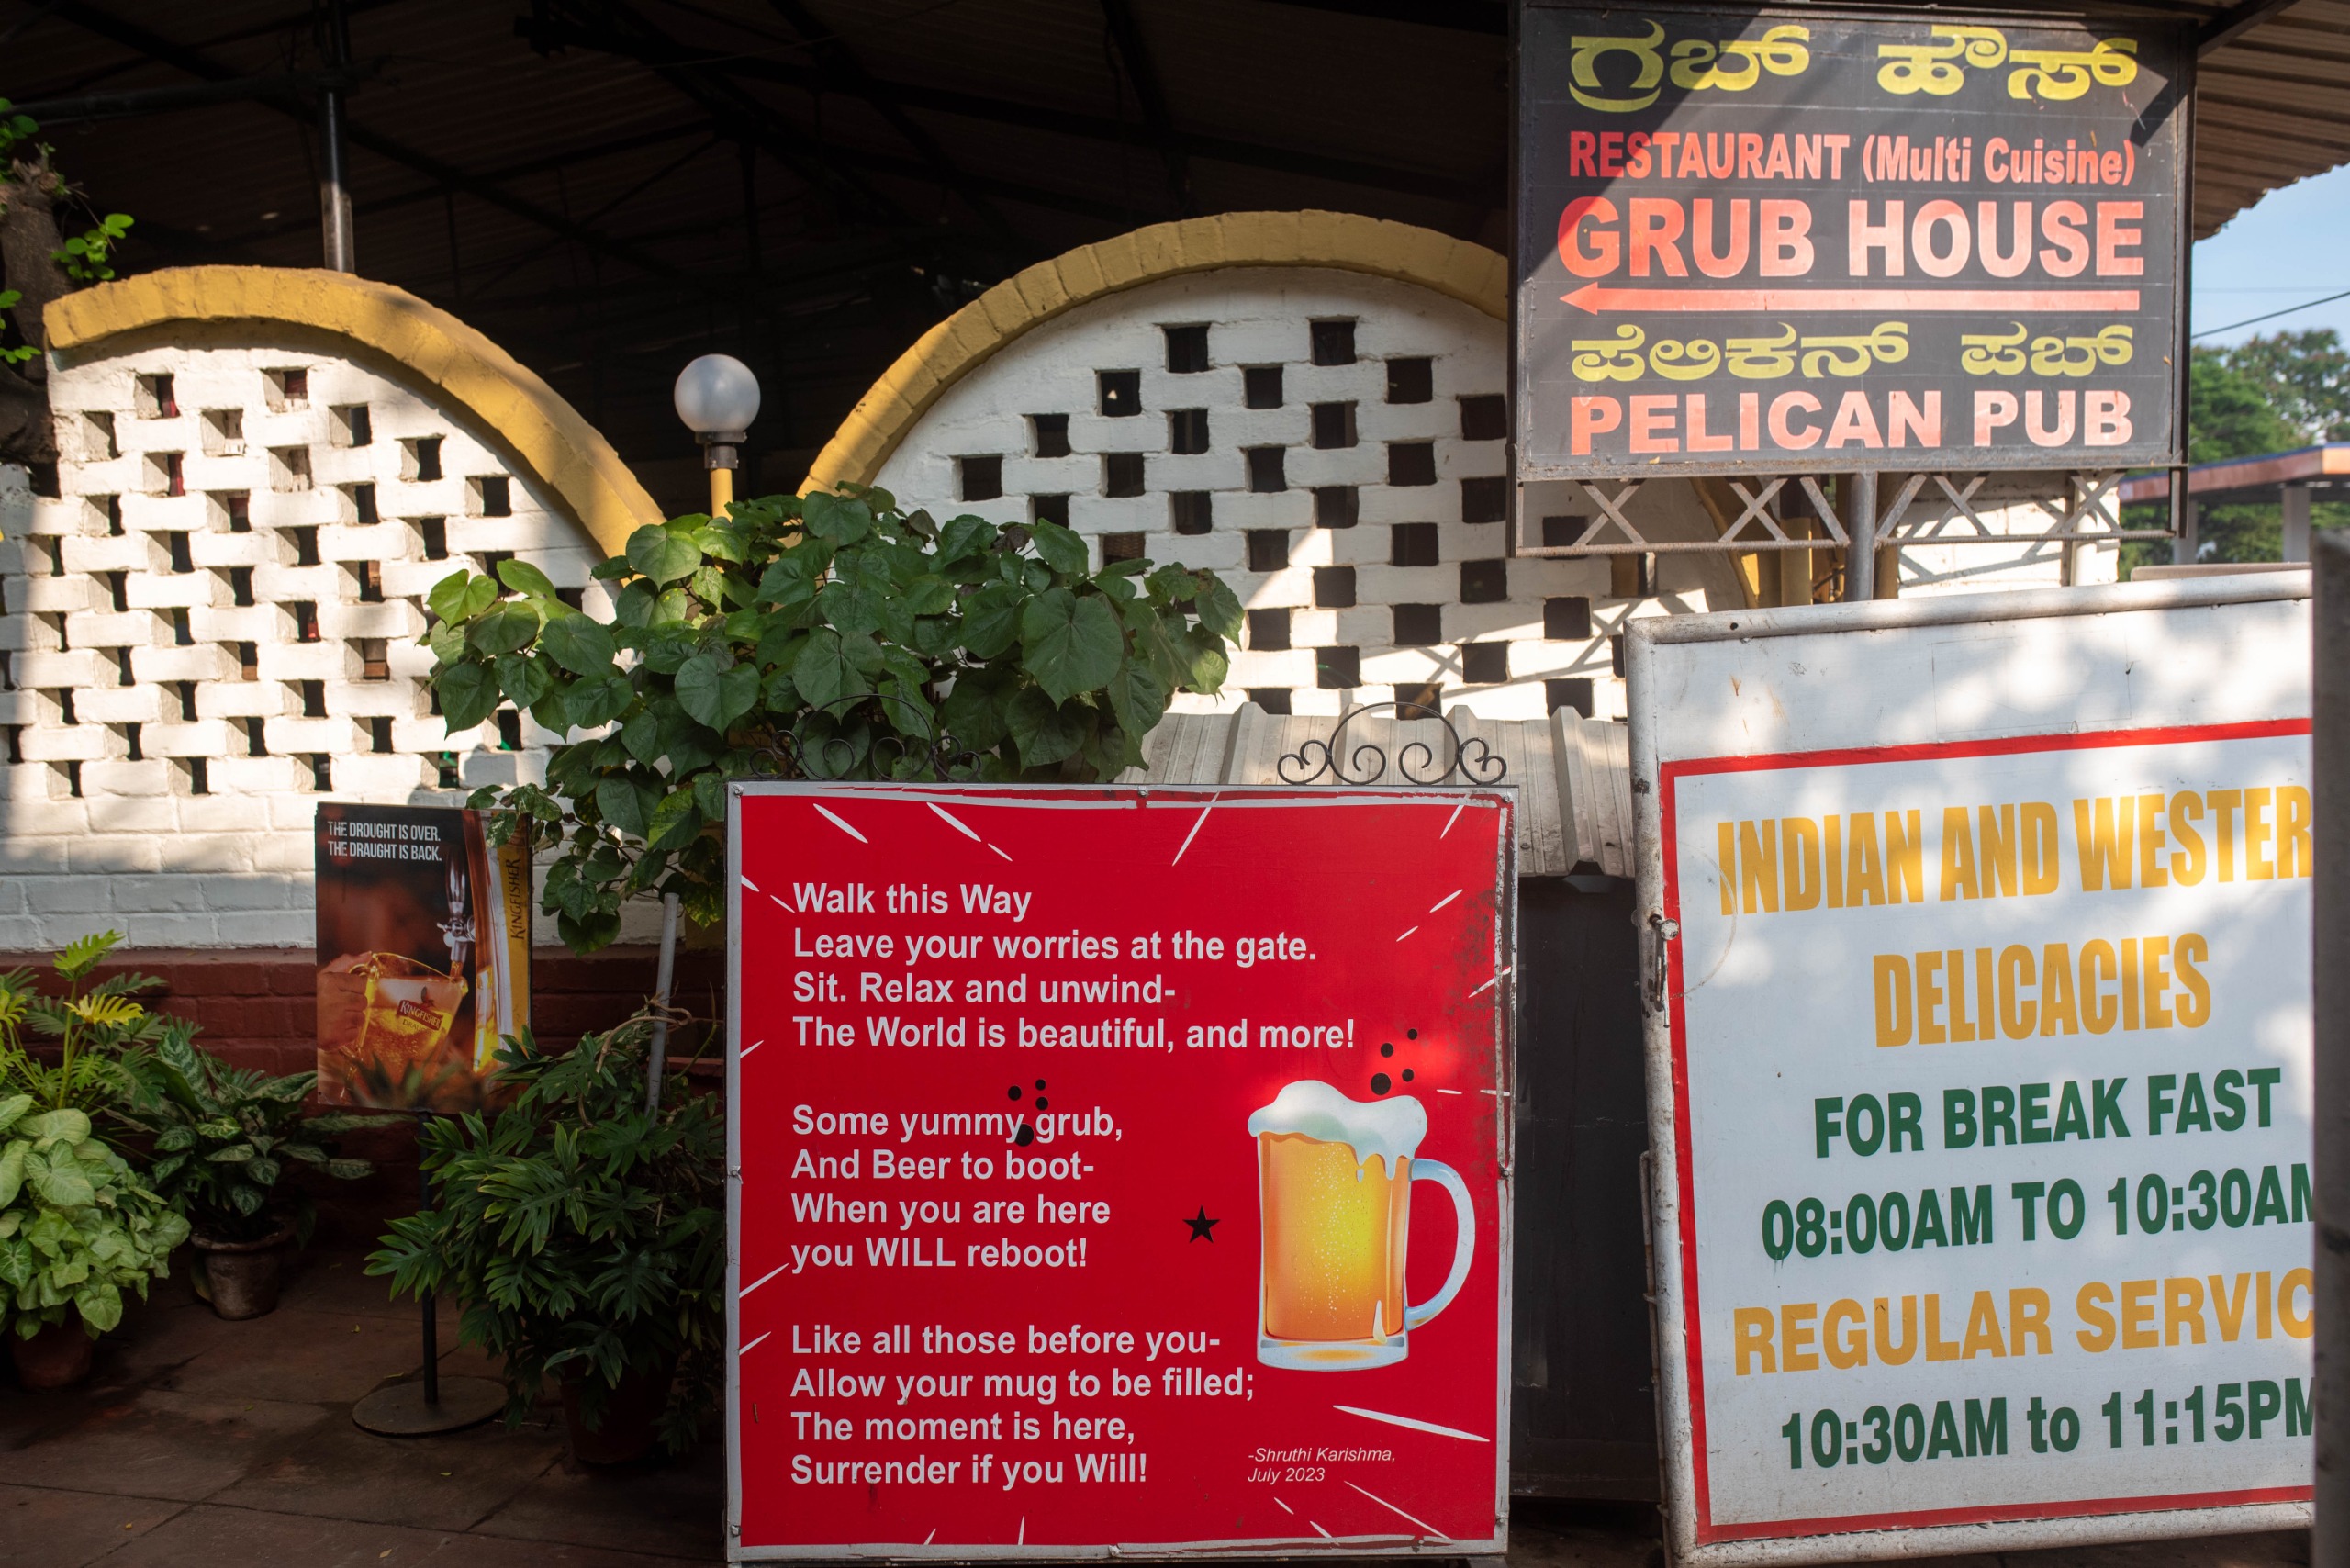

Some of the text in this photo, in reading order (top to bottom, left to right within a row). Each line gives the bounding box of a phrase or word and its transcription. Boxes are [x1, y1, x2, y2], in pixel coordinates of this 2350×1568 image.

[1568, 18, 2138, 113] ಗ್ರಬ್ ಹೌಸ್
[1570, 130, 2136, 187] RESTAURANT (Multi Cuisine)
[1557, 196, 2144, 278] GRUB HOUSE
[1572, 320, 2133, 381] ಪೆಲಿಕನ್ ಪಬ್
[1571, 389, 2134, 455] PELICAN PUB
[328, 822, 441, 841] THE DROUGHT IS OVER.
[1718, 786, 2313, 915] INDIAN AND WESTER
[328, 841, 442, 861] THE DRAUGHT IS BACK.
[506, 858, 525, 940] KINGFISHER
[790, 883, 1031, 922] Walk this Way
[795, 928, 1315, 968] Leave your worries at the gate.
[794, 971, 1175, 1003] Sit. Relax and unwind-
[1874, 933, 2210, 1047] DELICACIES
[400, 1001, 442, 1029] KINGFISHER
[793, 1016, 1353, 1053] The World is beautiful, and more!
[793, 1105, 1121, 1143] Some yummy grub,
[1815, 1068, 2280, 1158] FOR BREAK FAST
[791, 1149, 1093, 1180] And Beer to boot-
[791, 1193, 1110, 1230] When you are here
[1762, 1185, 1993, 1260] 08:00AM
[2012, 1179, 2085, 1240] TO
[791, 1238, 1086, 1273] you WILL reboot!
[1734, 1268, 2314, 1375] REGULAR SERVIC
[793, 1325, 1219, 1361] Like all those before you-
[790, 1367, 1252, 1405] Allow your mug to be filled;
[791, 1411, 1134, 1444] The moment is here,
[1781, 1398, 2007, 1468] 10:30AM
[2027, 1398, 2079, 1452] to
[791, 1454, 1146, 1490] Surrender if you Will!
[1248, 1447, 1395, 1463] -Shruthi Karishma,
[1248, 1467, 1325, 1484] July 2023
